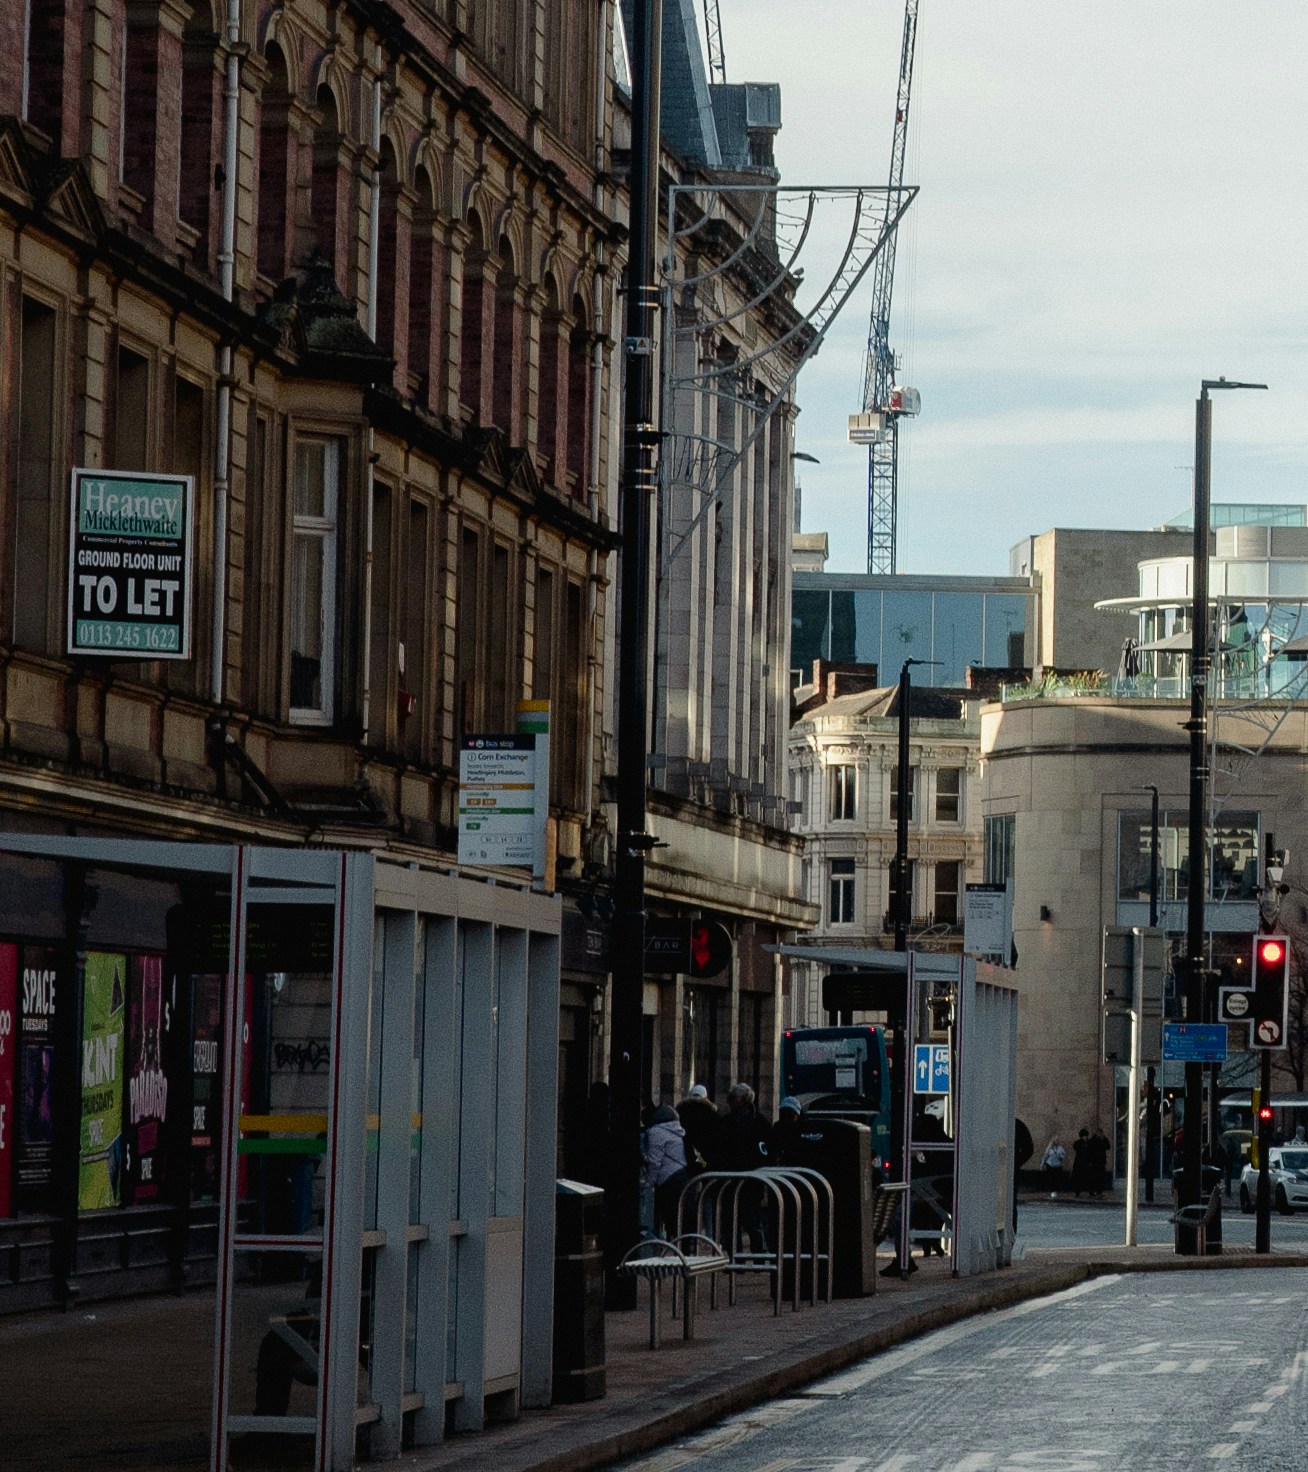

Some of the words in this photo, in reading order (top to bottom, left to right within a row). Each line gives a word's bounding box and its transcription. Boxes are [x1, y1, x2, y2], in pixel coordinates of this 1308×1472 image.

[84, 481, 178, 523] Heaney
[85, 509, 177, 539] Micklethwaite
[78, 549, 120, 568] GROUND
[122, 551, 155, 570] FLOOR
[158, 554, 182, 572] UNIT
[79, 574, 117, 614] TO
[127, 577, 179, 616] LET
[80, 624, 111, 645] 0113
[116, 626, 140, 646] 245
[145, 627, 176, 648] 1622
[23, 968, 56, 1015] SPACE
